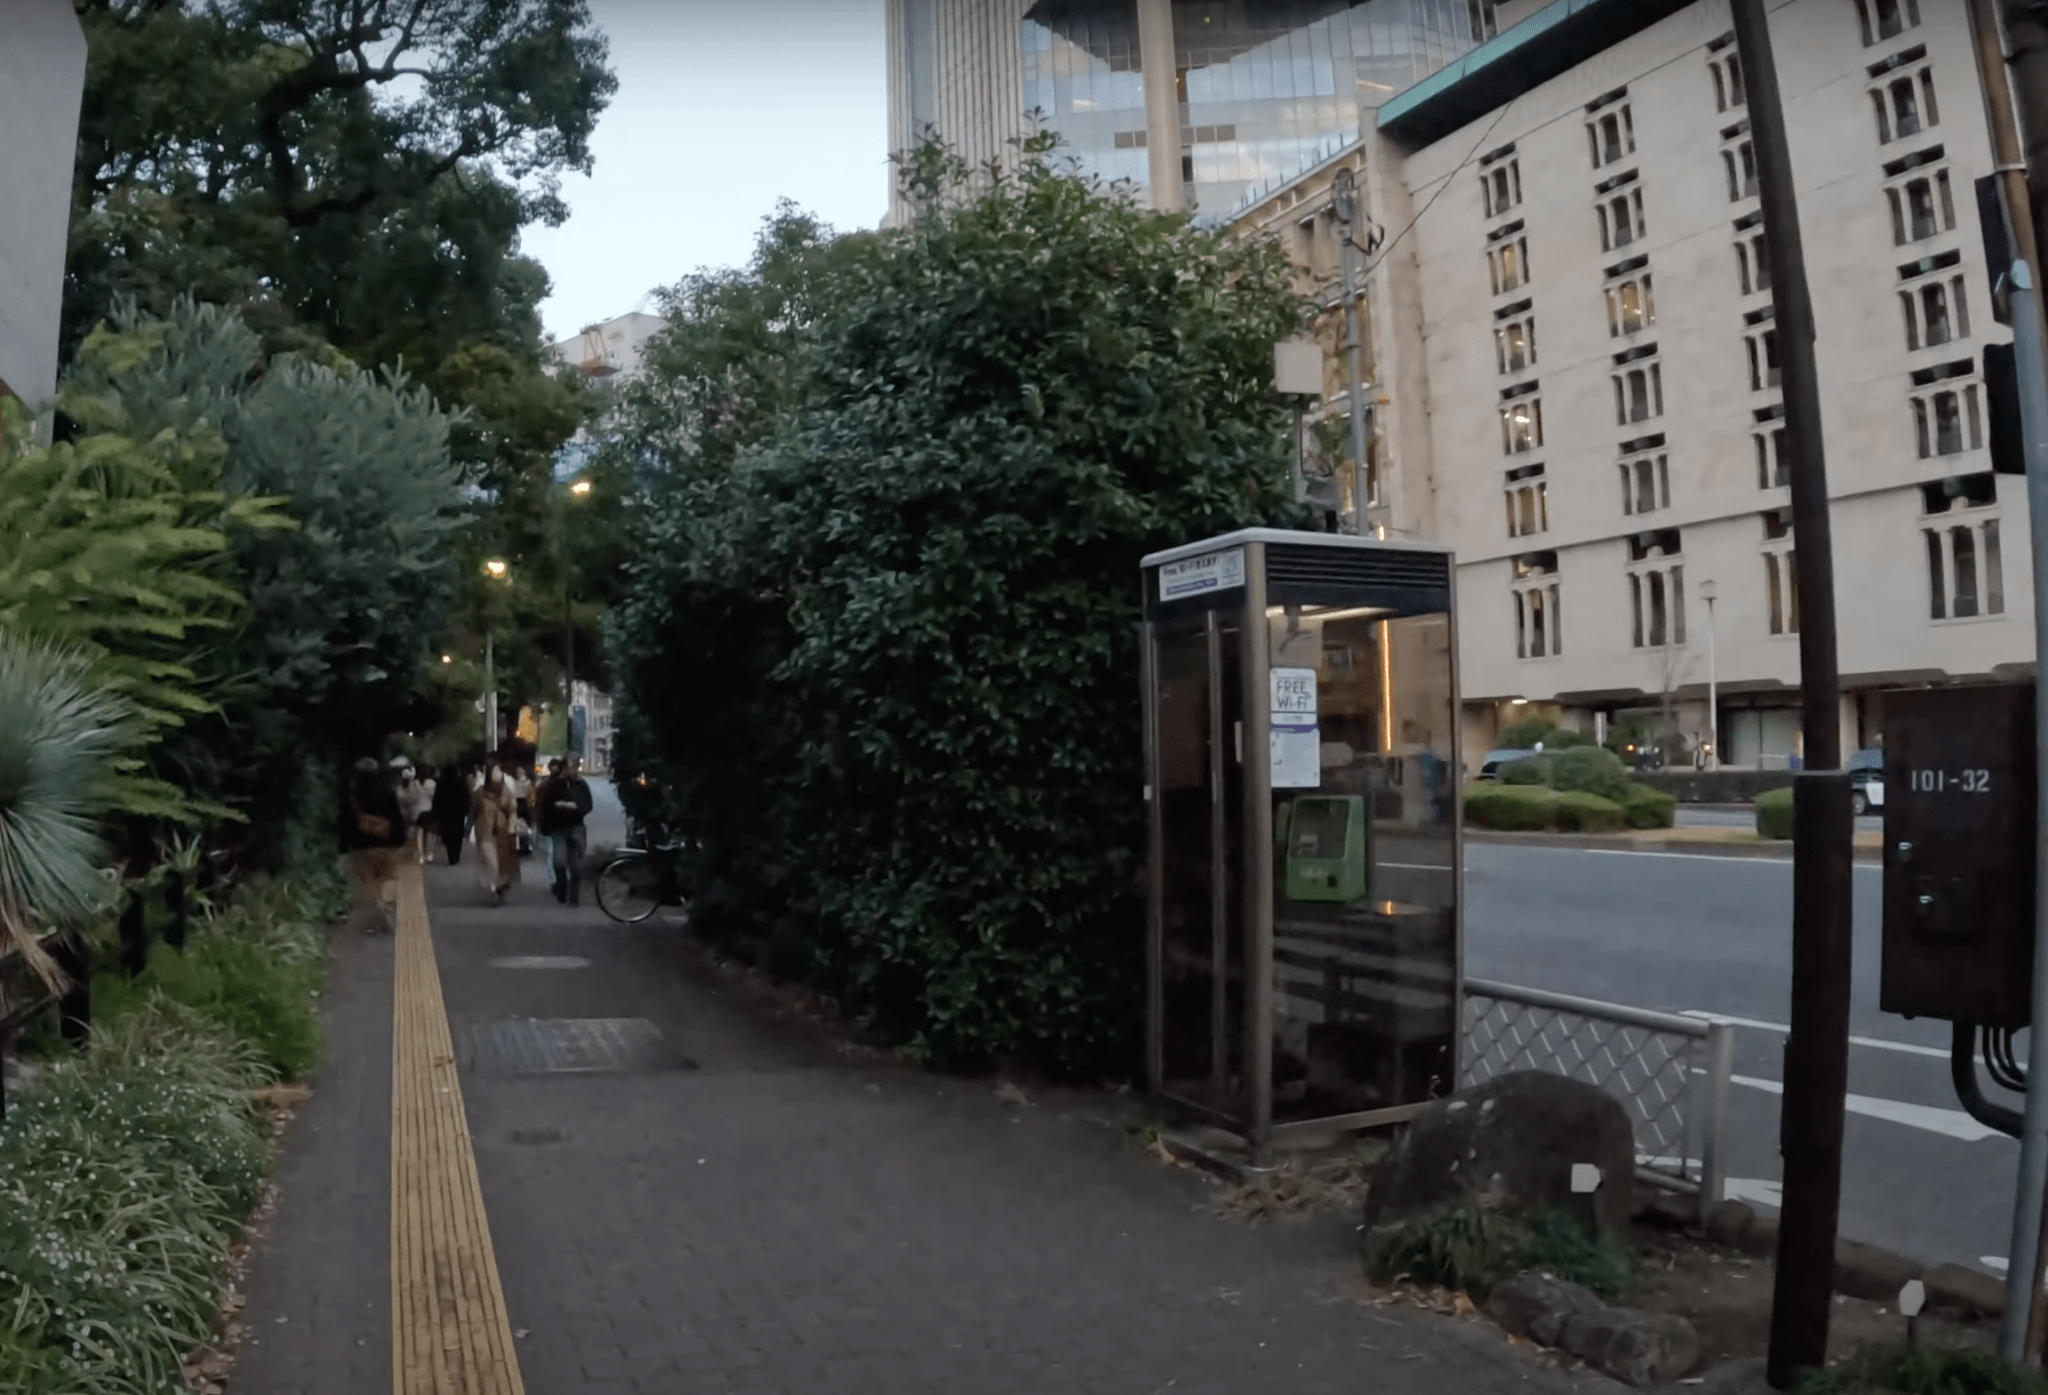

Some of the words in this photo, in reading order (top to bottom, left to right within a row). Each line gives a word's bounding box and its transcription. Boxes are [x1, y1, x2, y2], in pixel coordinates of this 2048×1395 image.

[1276, 680, 1307, 694] FREE
[1276, 695, 1307, 710] Wi-Fi
[1911, 769, 1990, 793] 101-32
